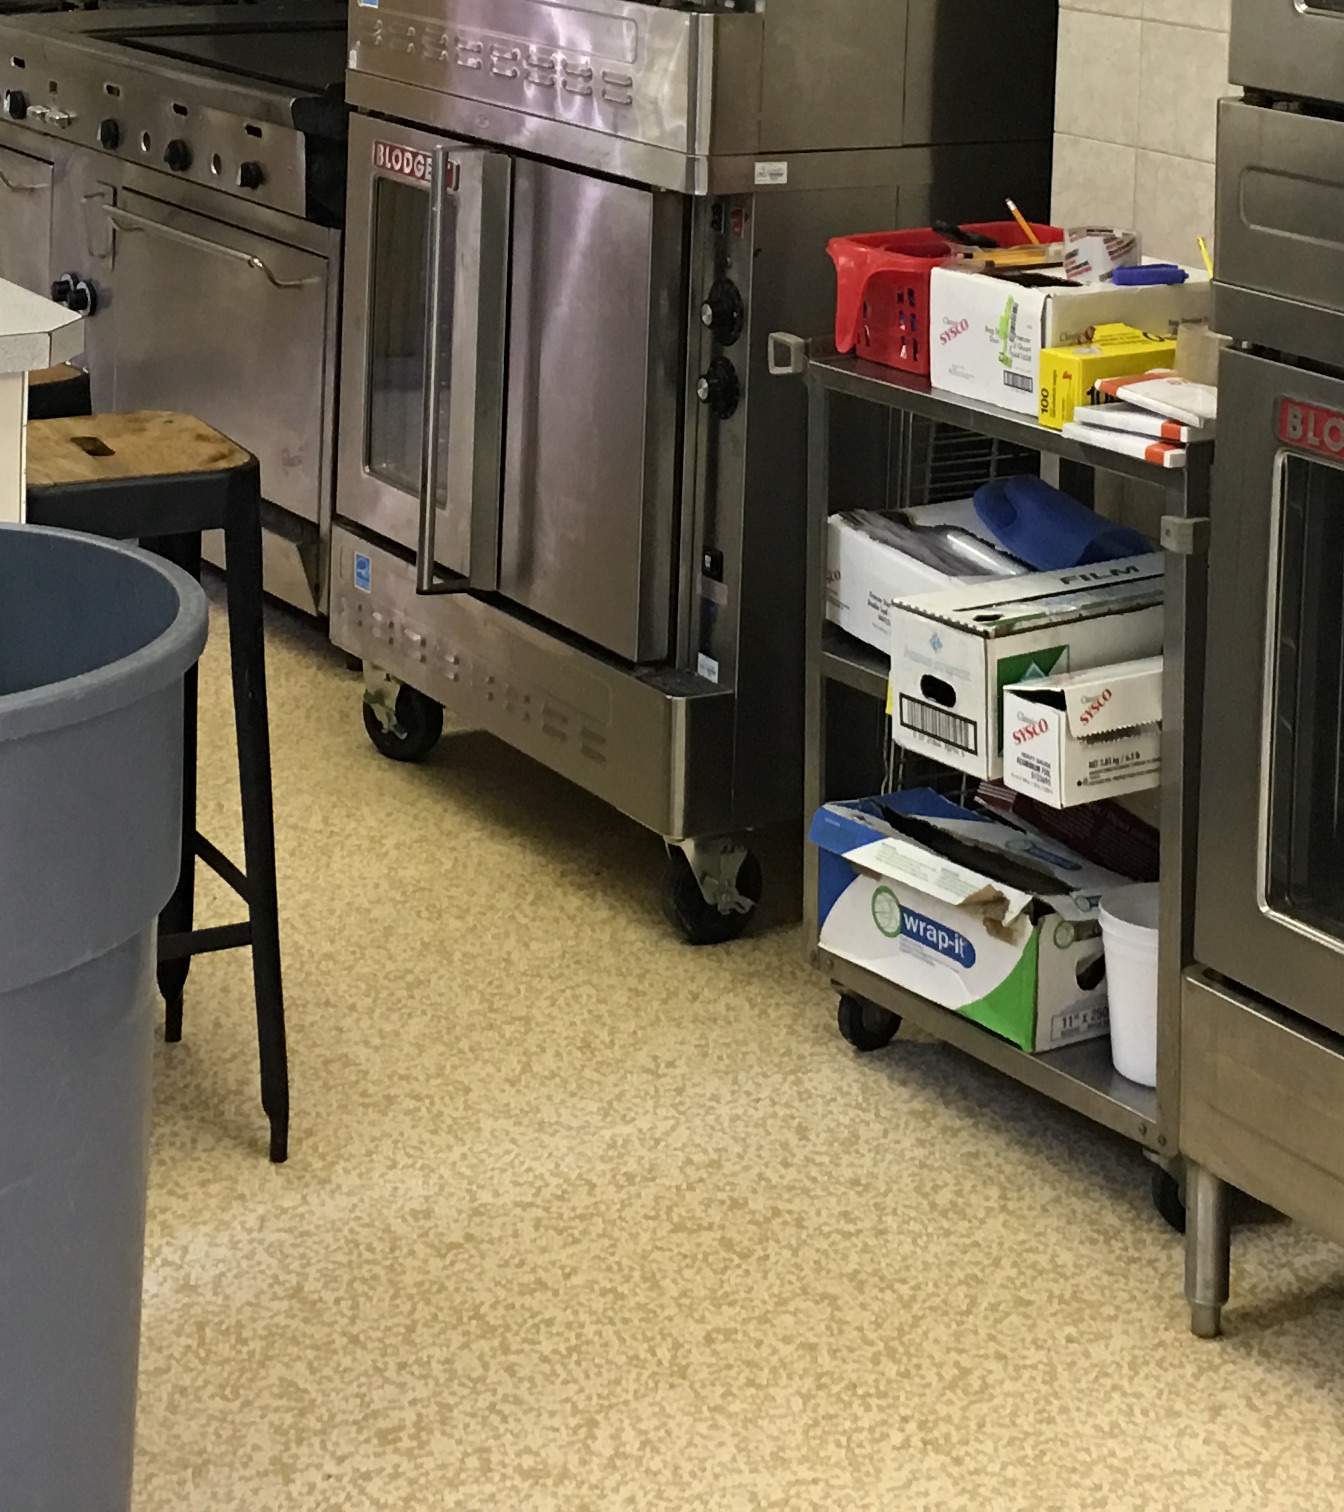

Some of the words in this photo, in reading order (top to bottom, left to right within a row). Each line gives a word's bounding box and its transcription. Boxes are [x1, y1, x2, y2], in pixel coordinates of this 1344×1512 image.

[376, 143, 452, 182] BLODGE
[939, 318, 969, 345] SYSCO
[1041, 388, 1050, 414] 100
[1059, 565, 1140, 585] FILM
[1079, 688, 1113, 726] SYSCO
[1012, 718, 1049, 746] SYSCO
[903, 912, 967, 958] wrap-it
